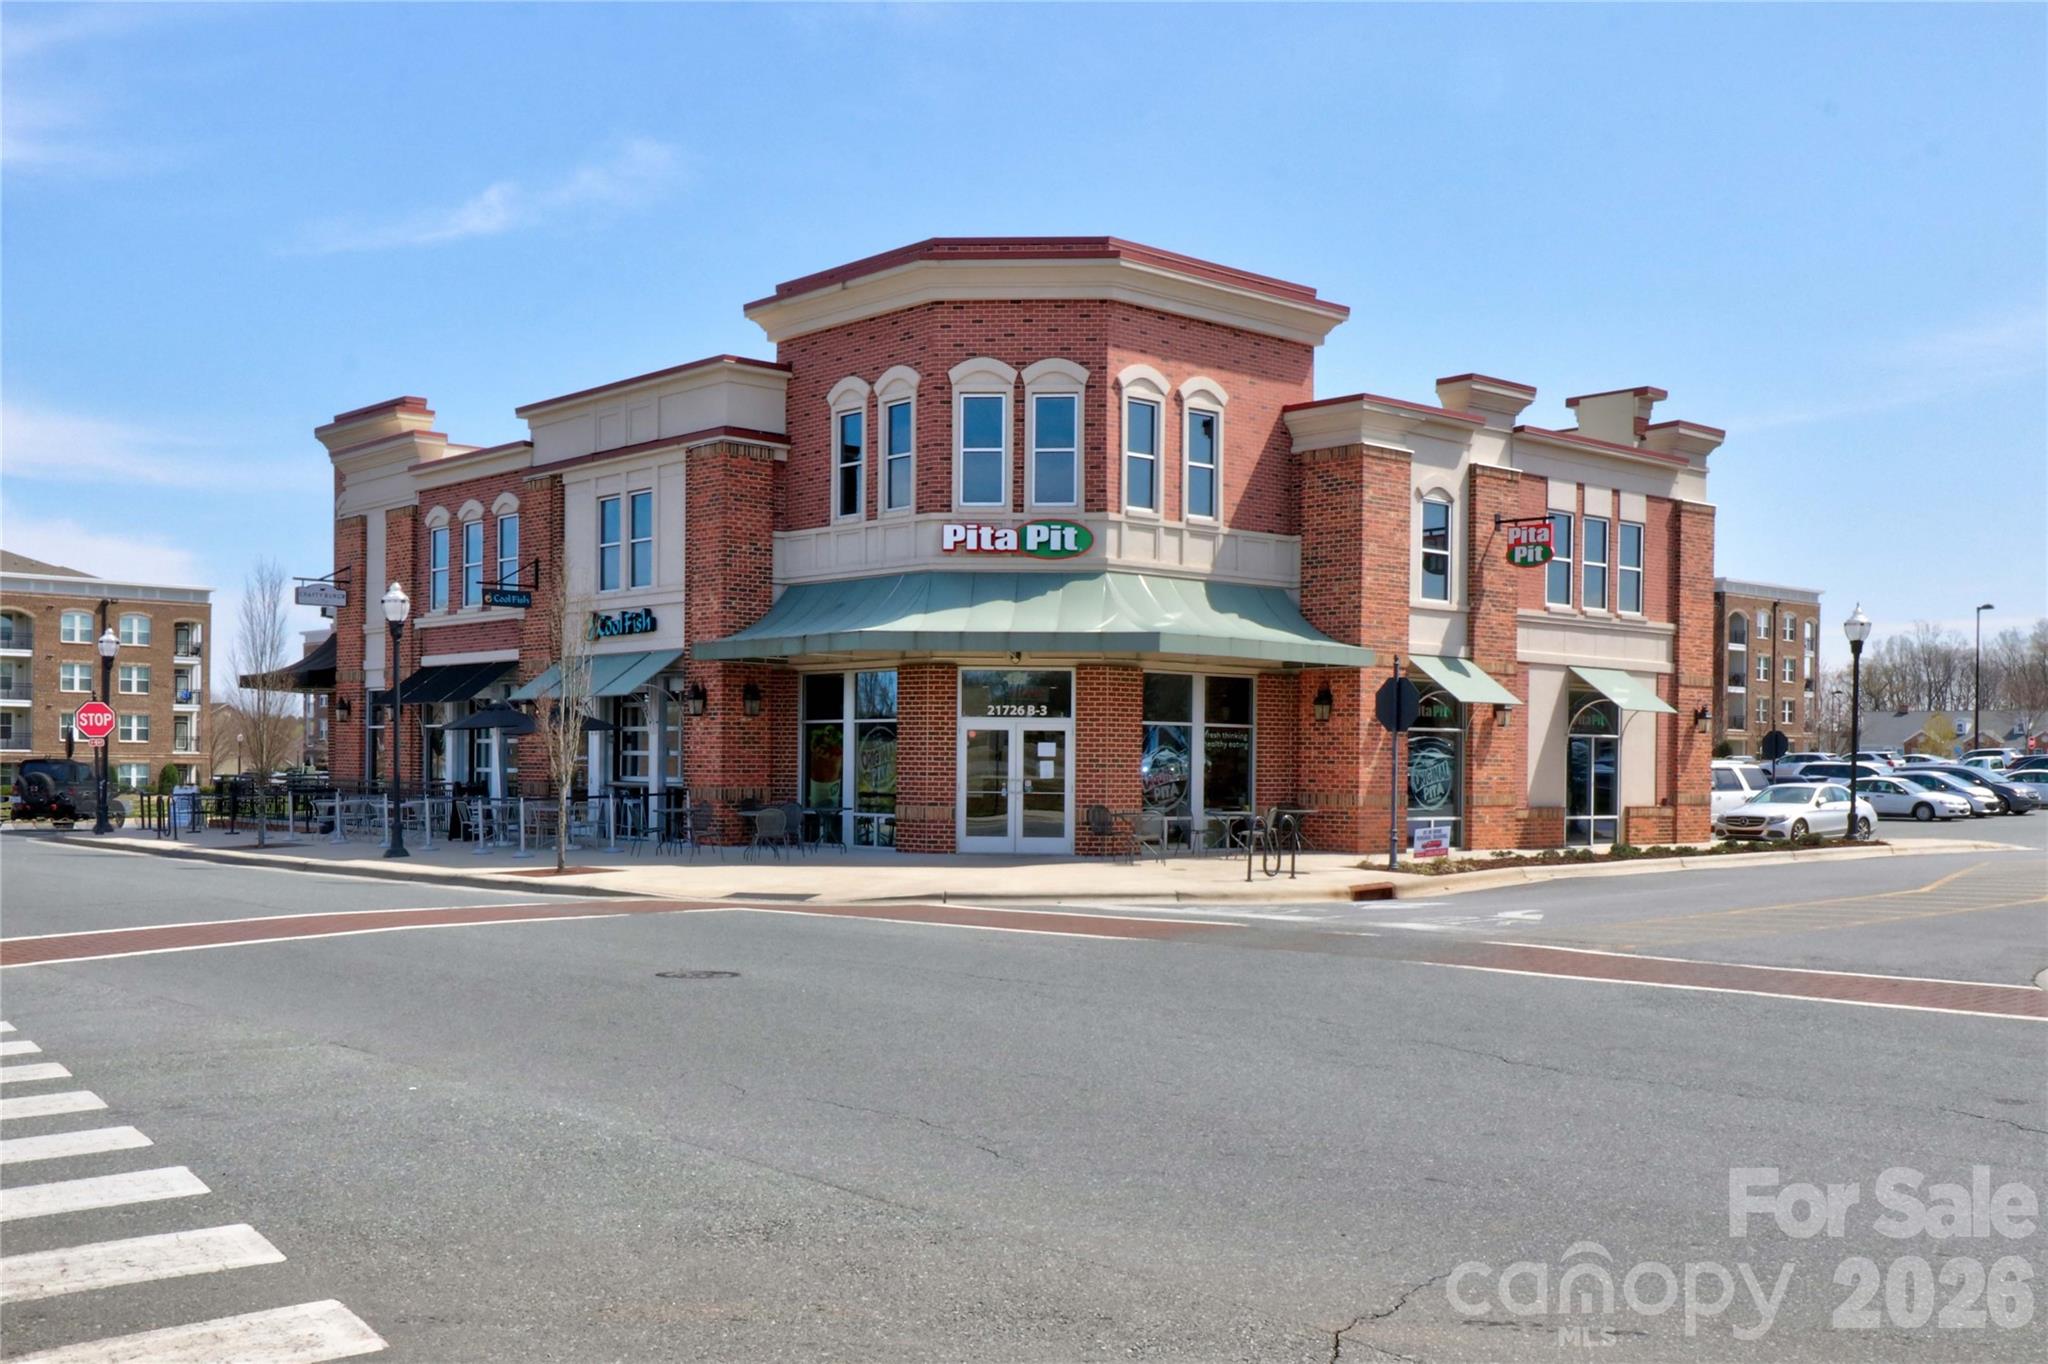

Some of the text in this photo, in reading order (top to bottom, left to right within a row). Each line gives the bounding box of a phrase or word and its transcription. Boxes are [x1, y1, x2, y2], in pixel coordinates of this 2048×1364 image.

[942, 524, 1078, 551] Pita Pit
[1508, 526, 1550, 545] Pita
[1514, 545, 1544, 563] Pit
[987, 705, 1048, 715] 21726 B-3
[79, 712, 113, 727] STOP
[1154, 782, 1179, 801] PITA
[1423, 783, 1445, 801] PITA
